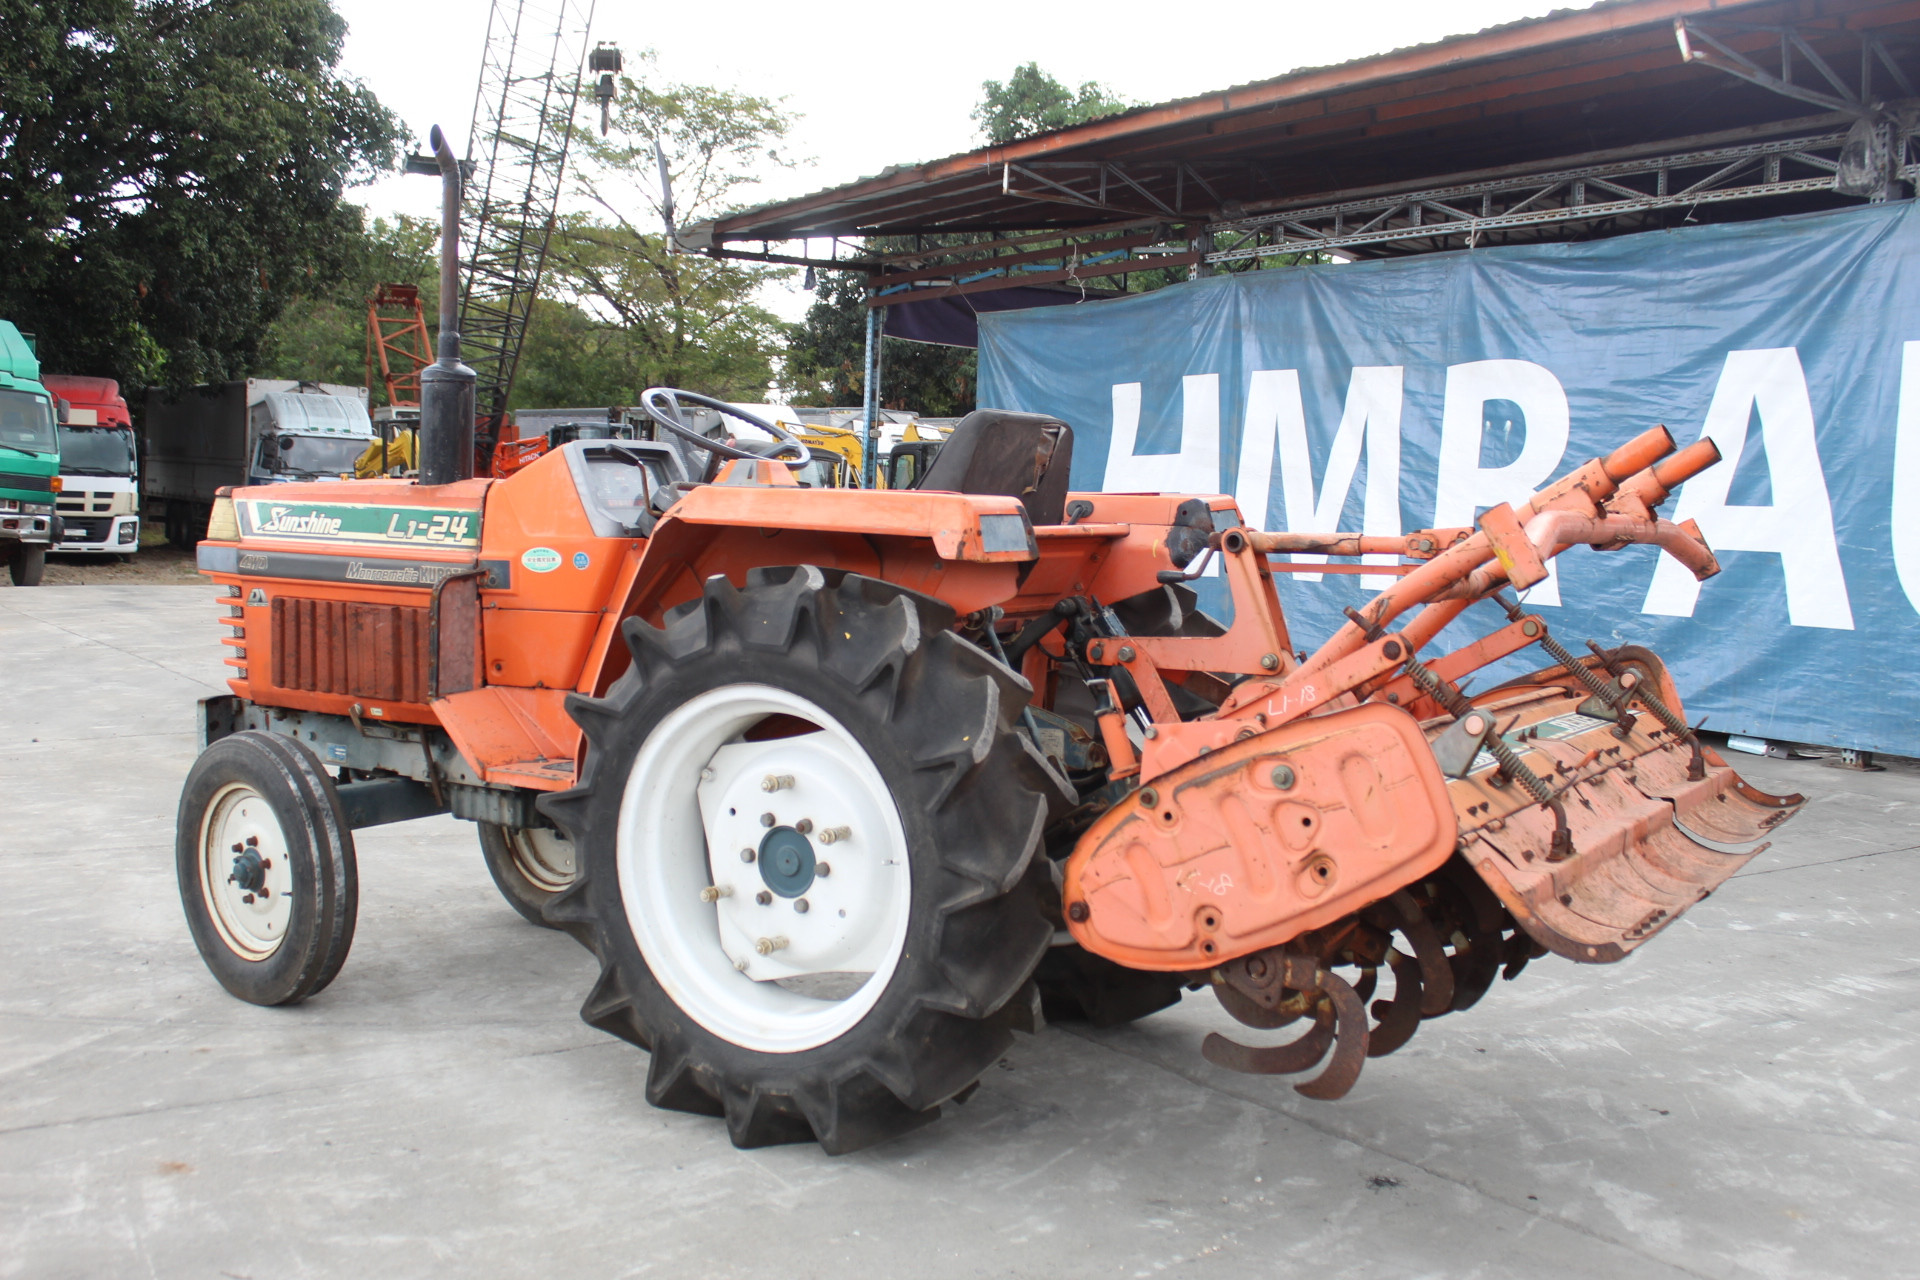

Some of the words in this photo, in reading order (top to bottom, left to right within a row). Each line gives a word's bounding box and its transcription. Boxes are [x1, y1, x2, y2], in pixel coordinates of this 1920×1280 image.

[1102, 358, 1571, 607] HMR
[1640, 340, 1920, 631] A
[258, 506, 342, 536] Sunshine
[386, 513, 469, 542] L1-24
[345, 561, 419, 583] Monroematic
